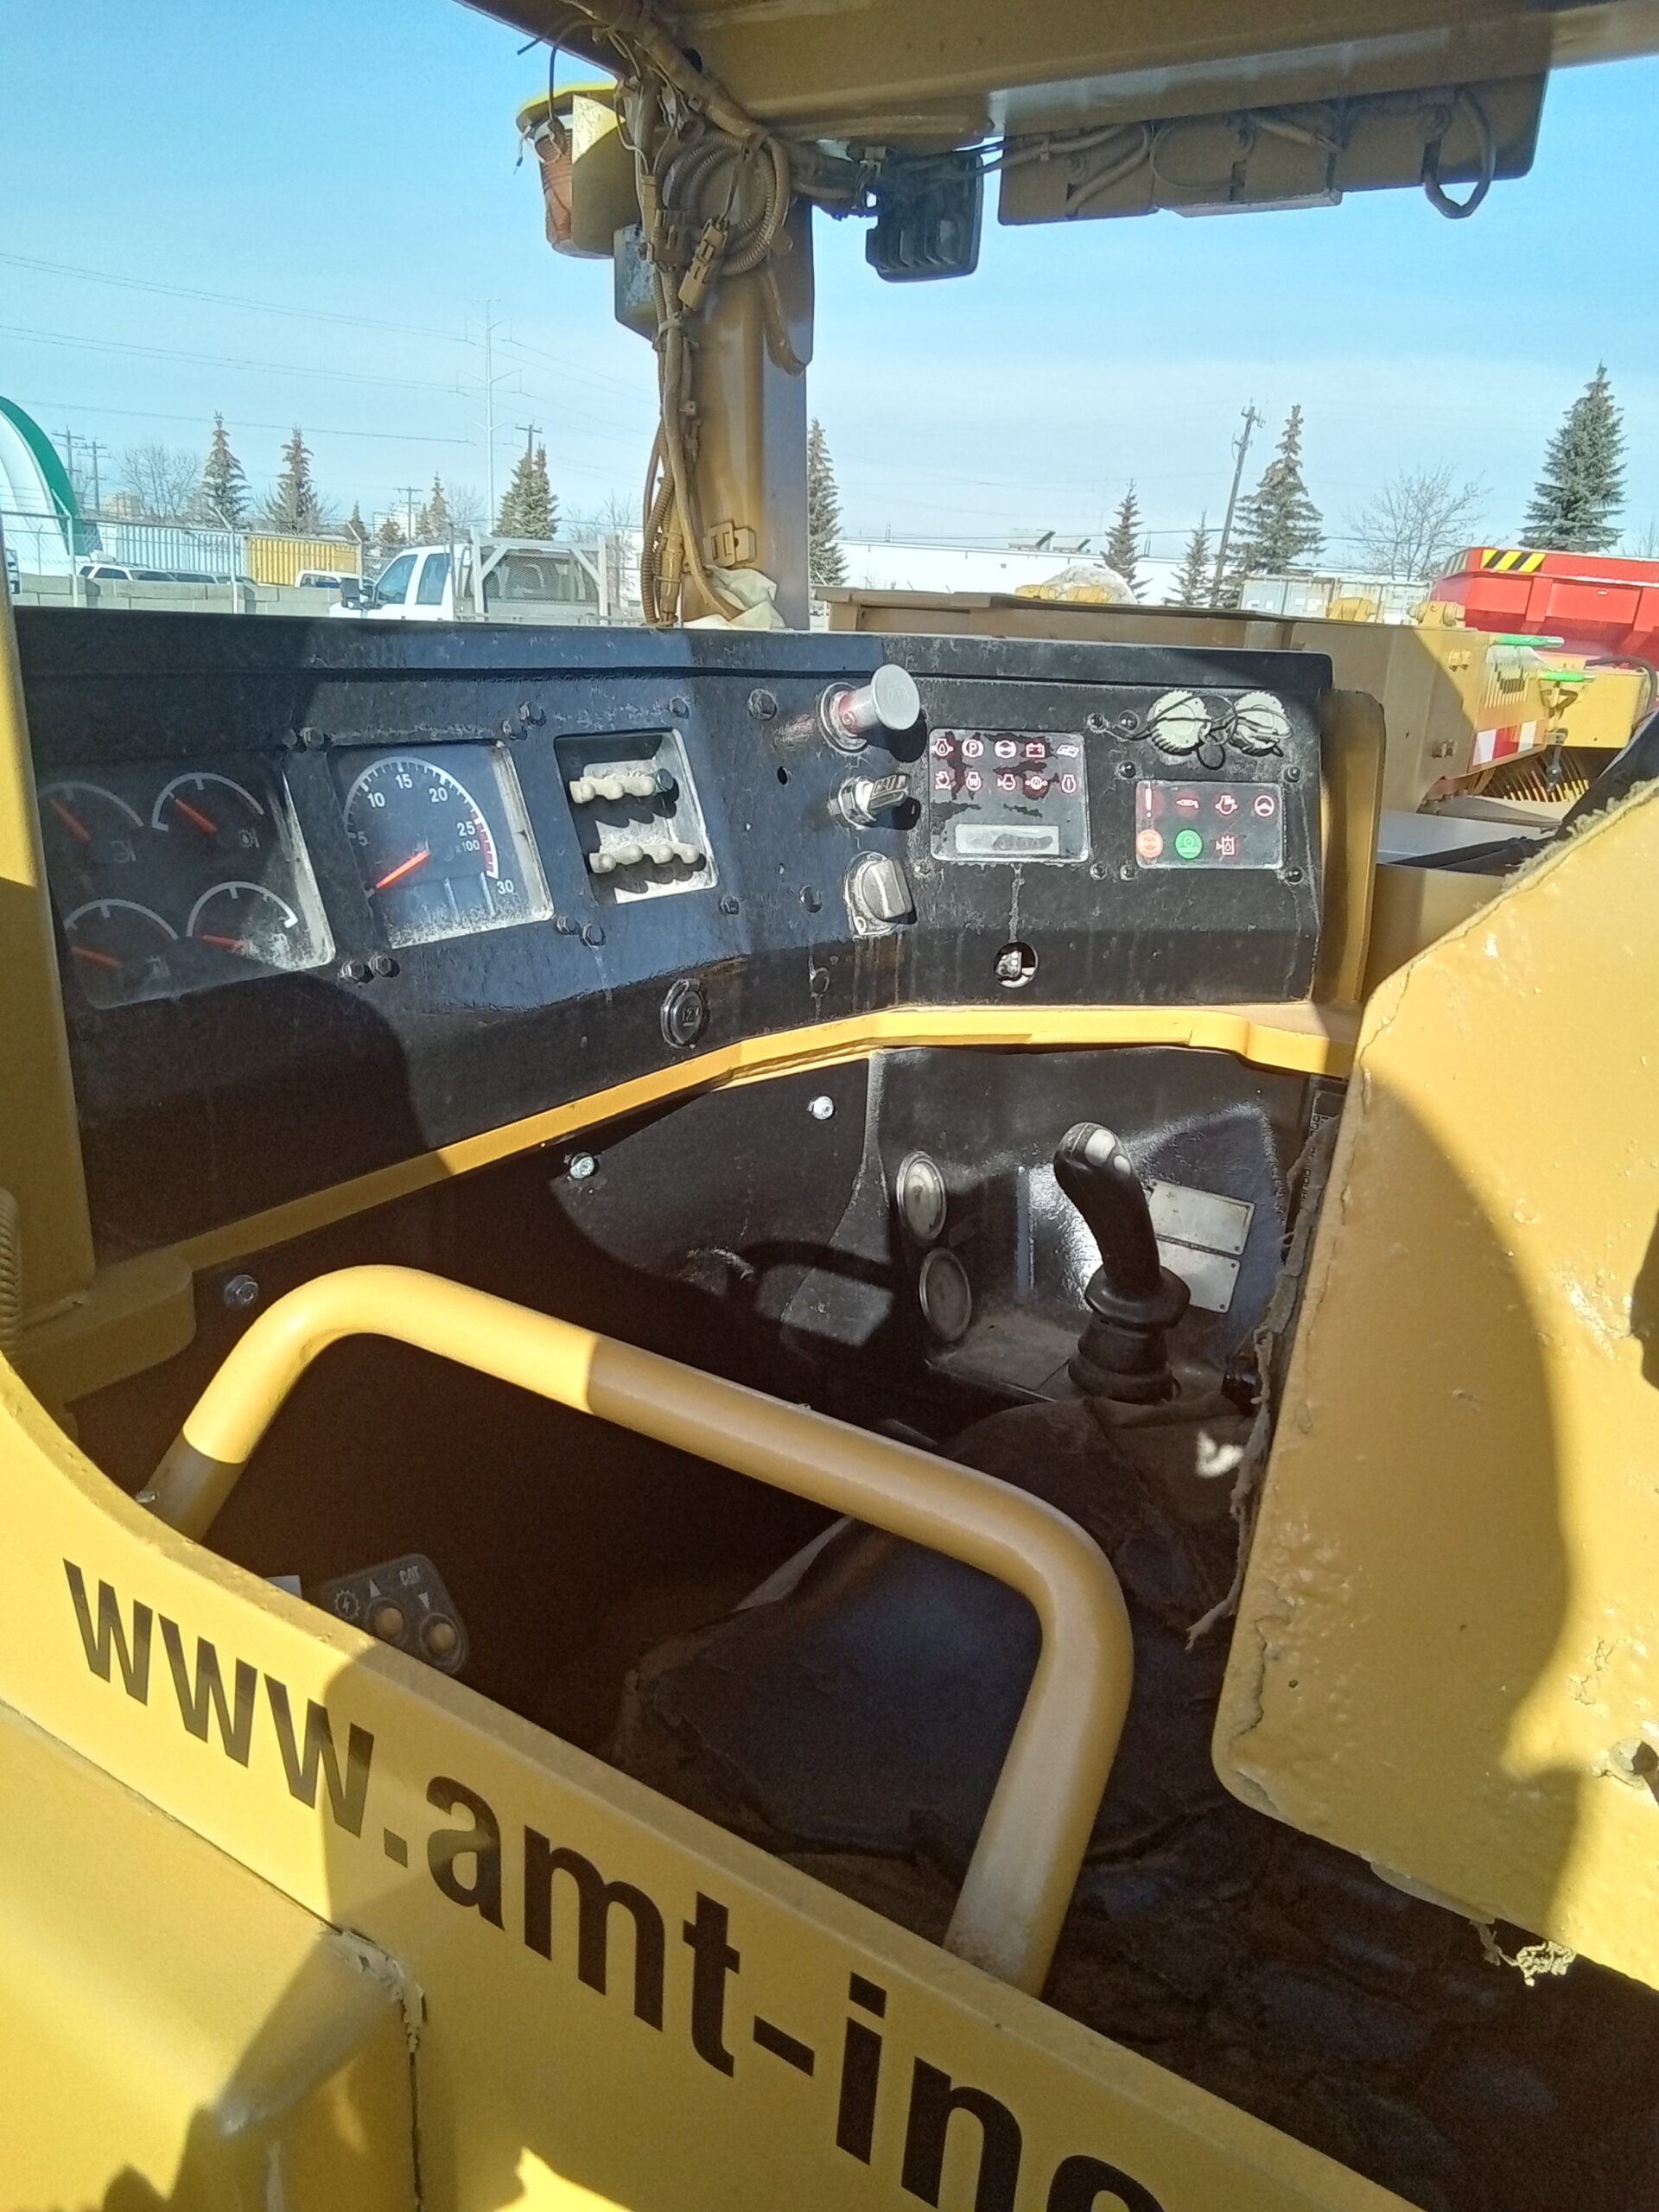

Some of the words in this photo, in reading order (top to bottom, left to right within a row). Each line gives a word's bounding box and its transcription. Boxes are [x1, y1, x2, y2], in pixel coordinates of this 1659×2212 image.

[395, 773, 413, 789] 15
[366, 791, 385, 808] 10
[429, 787, 448, 803] 20
[456, 821, 476, 836] 25
[356, 832, 368, 847] 5
[496, 879, 514, 895] 30
